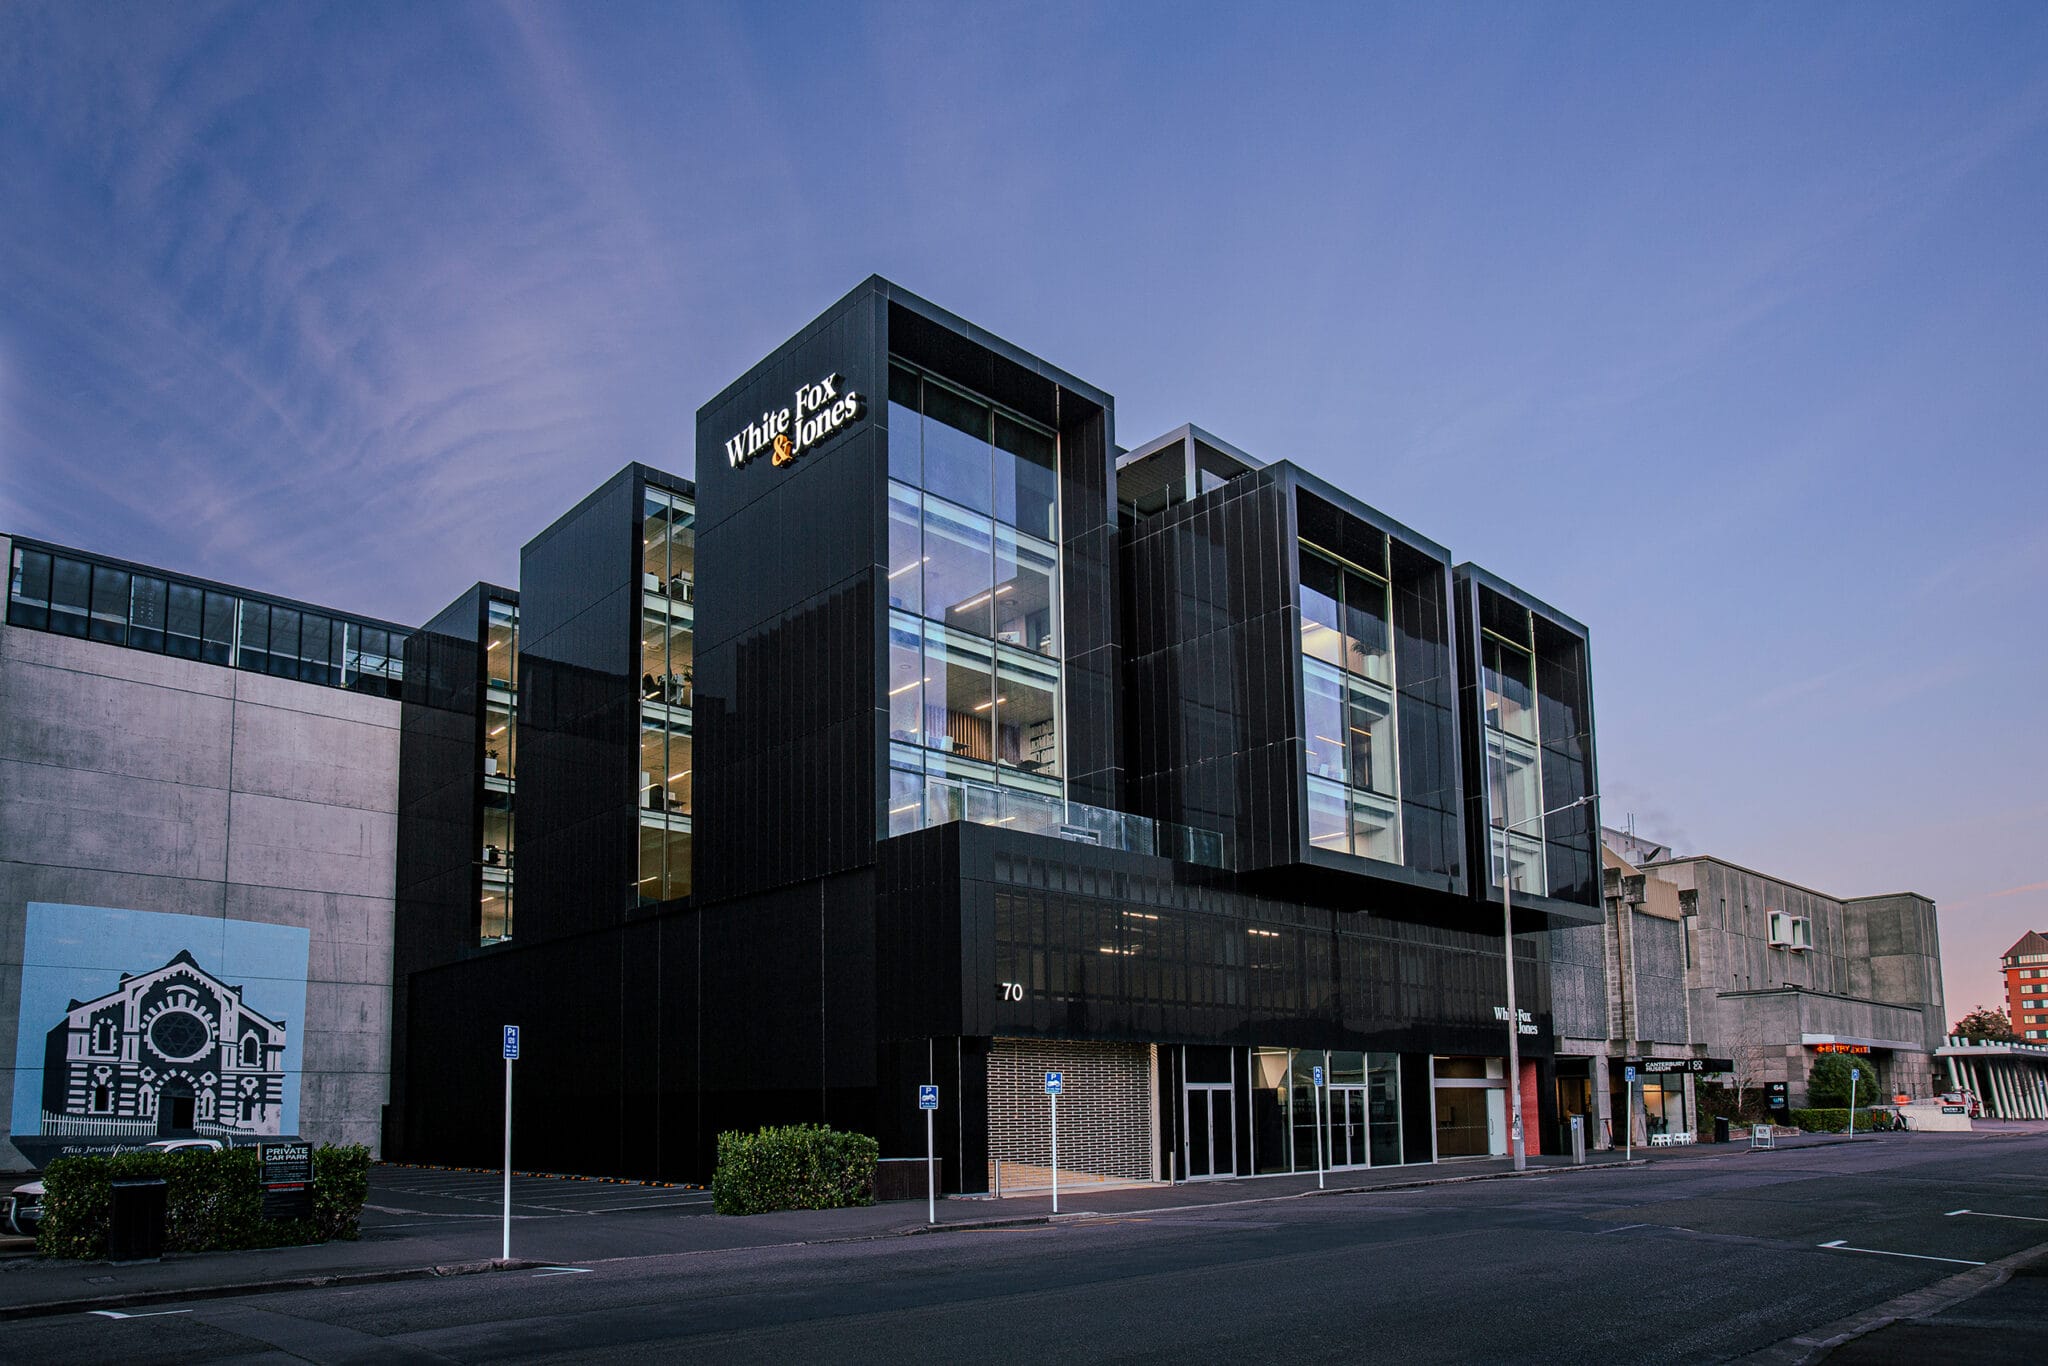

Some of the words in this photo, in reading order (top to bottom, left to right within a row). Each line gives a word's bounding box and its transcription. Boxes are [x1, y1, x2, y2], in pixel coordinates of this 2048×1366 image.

[725, 408, 790, 467] White
[795, 372, 837, 420] Fox
[771, 433, 793, 467] &
[792, 391, 858, 455] Jones
[1002, 982, 1023, 1001] 70
[1517, 1008, 1532, 1022] Fox
[1517, 1021, 1538, 1035] Jones
[1645, 1060, 1685, 1068] CANTERBURY
[62, 1146, 82, 1154] This
[266, 1147, 308, 1155] PRIVATE
